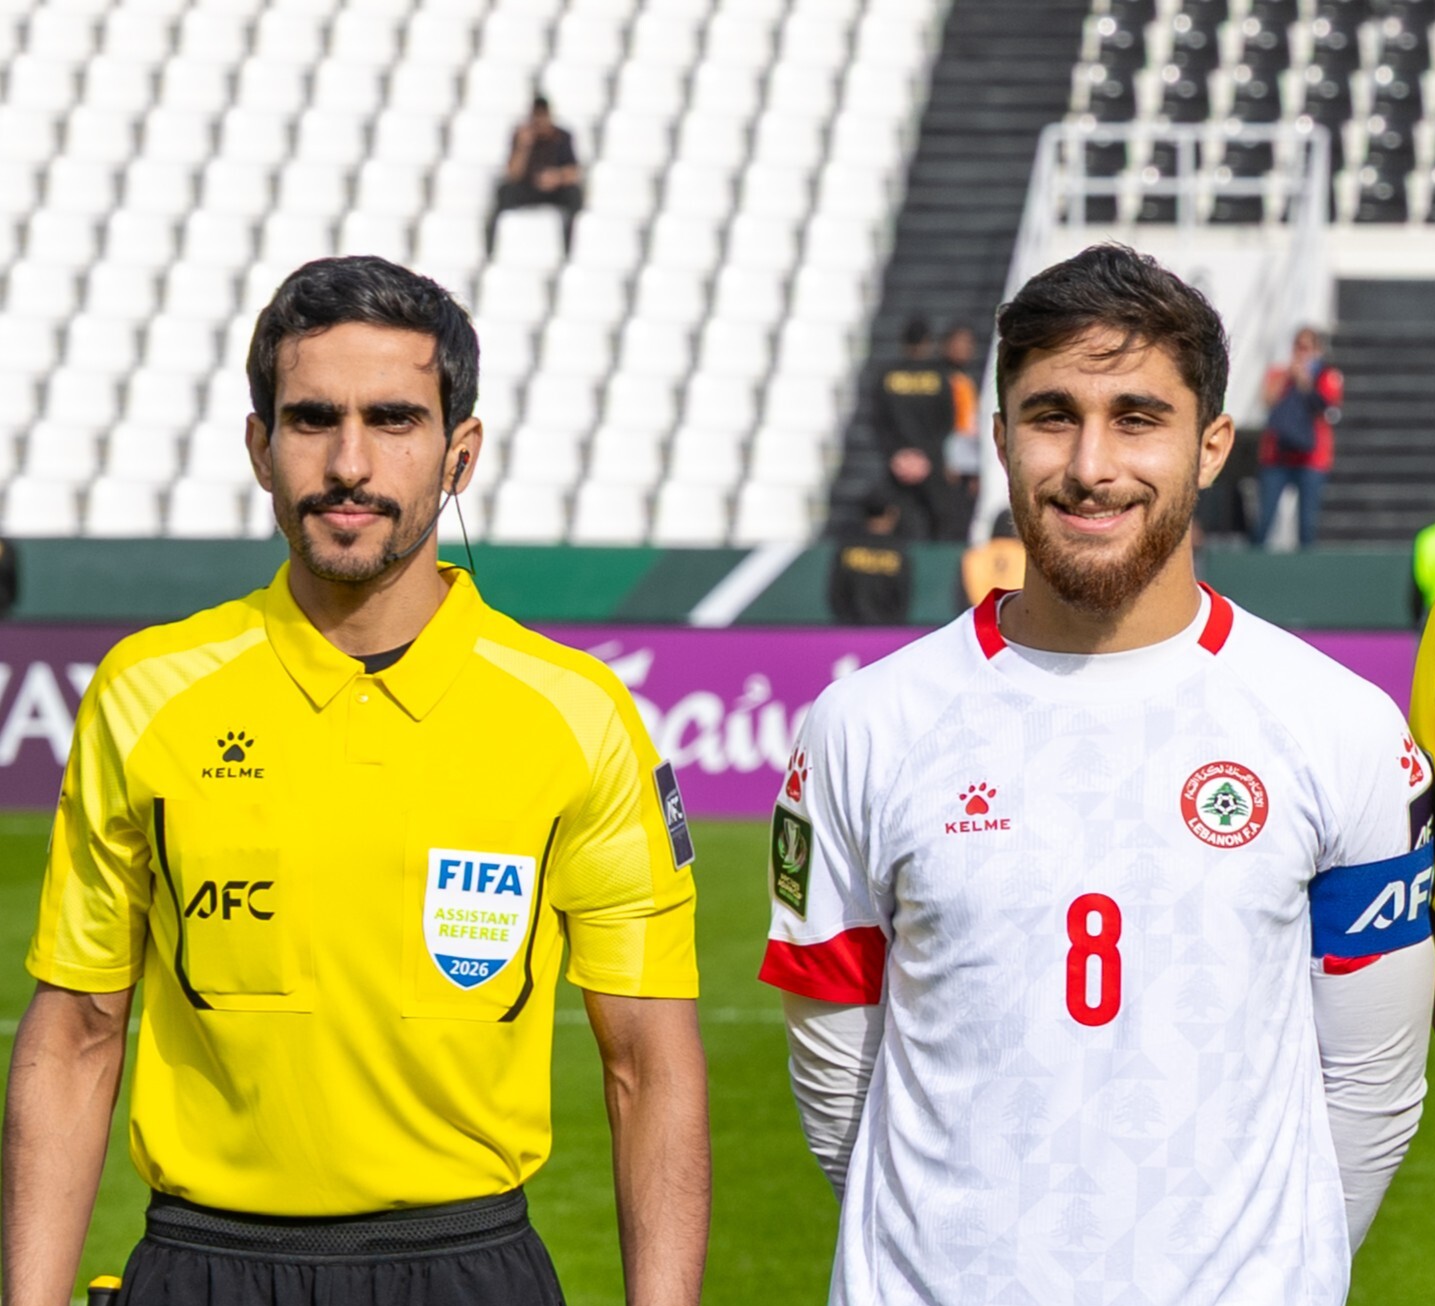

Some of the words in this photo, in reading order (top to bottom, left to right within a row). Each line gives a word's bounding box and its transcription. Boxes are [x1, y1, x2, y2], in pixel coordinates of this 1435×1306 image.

[201, 768, 264, 779] KELME
[945, 818, 1011, 834] KELME
[1188, 817, 1243, 846] LEBANON
[438, 859, 522, 897] FIFA
[185, 880, 274, 920] AFC
[1345, 865, 1434, 934] AF
[434, 907, 519, 927] ASSISTANT
[439, 924, 510, 942] REFEREE
[450, 960, 489, 977] 2026
[1065, 893, 1122, 1027] 8
